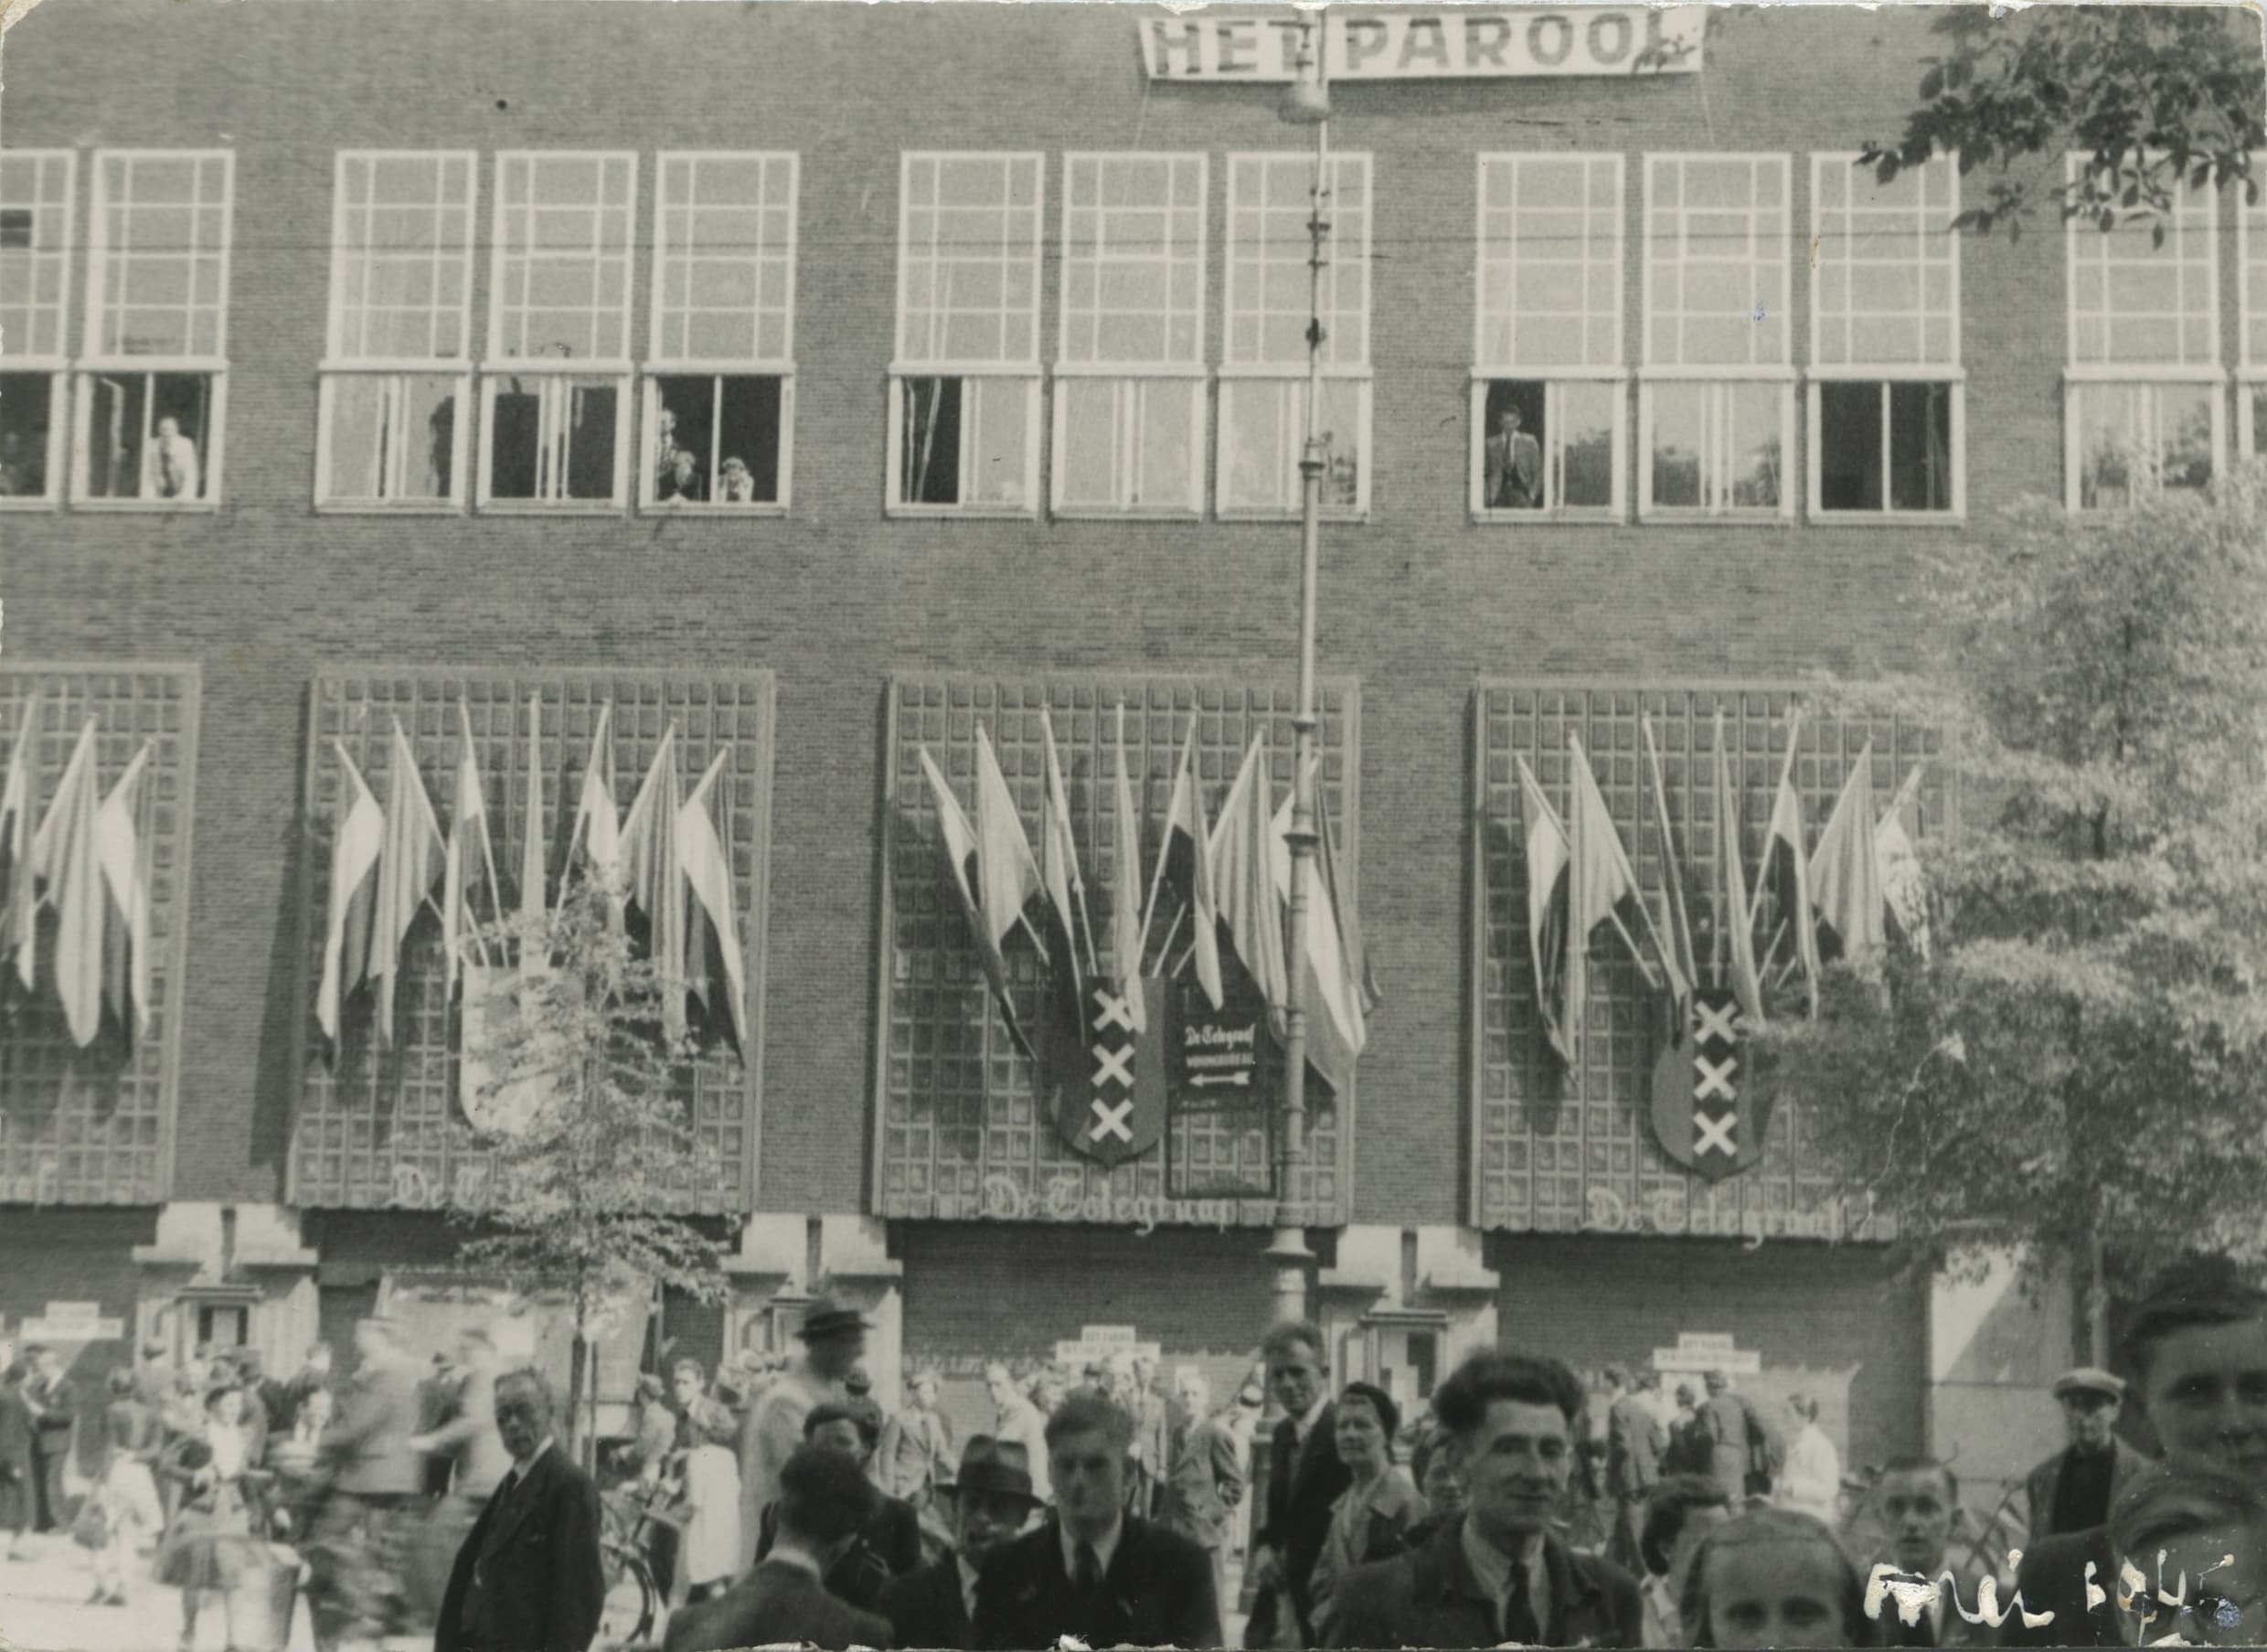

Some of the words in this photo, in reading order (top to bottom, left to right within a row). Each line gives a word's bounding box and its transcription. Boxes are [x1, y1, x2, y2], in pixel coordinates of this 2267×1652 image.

[1153, 20, 1314, 74] HET
[1346, 9, 1687, 71] PAROOL
[1185, 1025, 1200, 1046] De
[978, 1174, 1039, 1220] De
[1581, 1186, 1644, 1234] De
